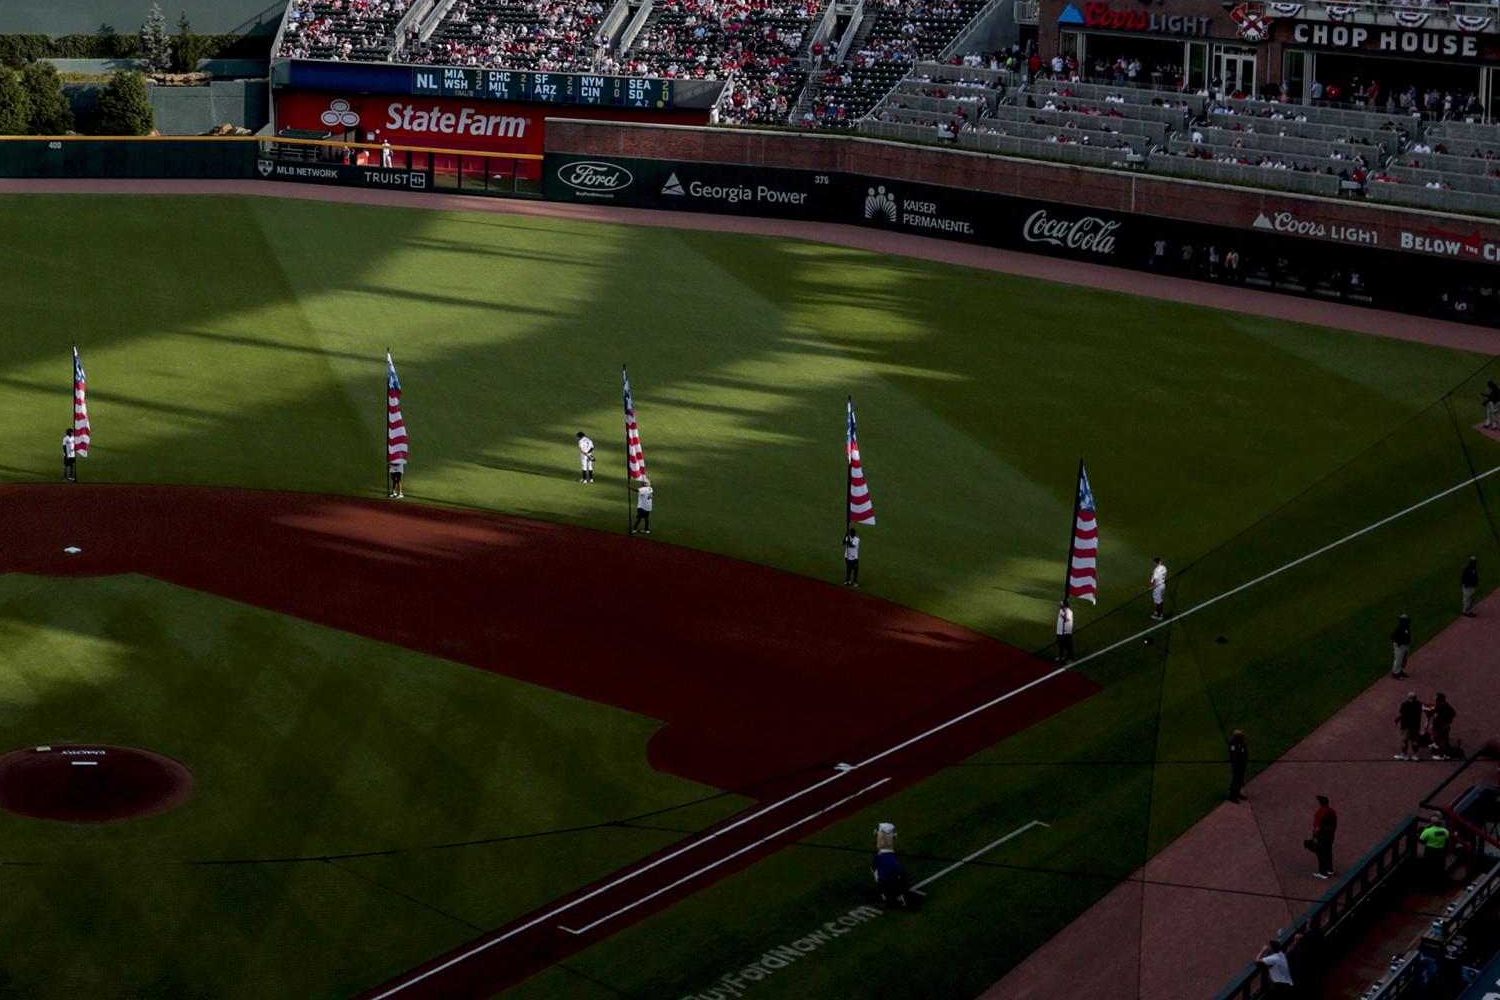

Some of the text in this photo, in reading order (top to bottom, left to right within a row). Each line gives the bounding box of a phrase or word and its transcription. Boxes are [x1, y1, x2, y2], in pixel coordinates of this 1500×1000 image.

[1085, 1, 1149, 31] Coors
[1150, 14, 1211, 34] LIGHT
[1294, 23, 1368, 48] CHOP
[1380, 29, 1479, 57] HOUSE
[444, 69, 465, 79] MIA
[489, 71, 511, 81] CHC
[534, 74, 549, 84] SF
[416, 74, 438, 88] NL
[444, 79, 468, 89] WSH
[488, 82, 508, 92] MIL
[581, 77, 604, 87] NYM
[629, 79, 652, 90] SEA
[534, 85, 557, 95] ARZ
[581, 87, 600, 97] CIN
[629, 90, 644, 100] SD
[276, 166, 338, 179] MLB NETWORK
[364, 171, 409, 184] TRUIST
[570, 164, 619, 187] Ford
[689, 181, 807, 204] Georgia Power
[903, 200, 936, 214] KAISER
[903, 214, 971, 234] PERMANENTE
[1274, 211, 1326, 236] Coors
[1400, 231, 1461, 256] BELOW
